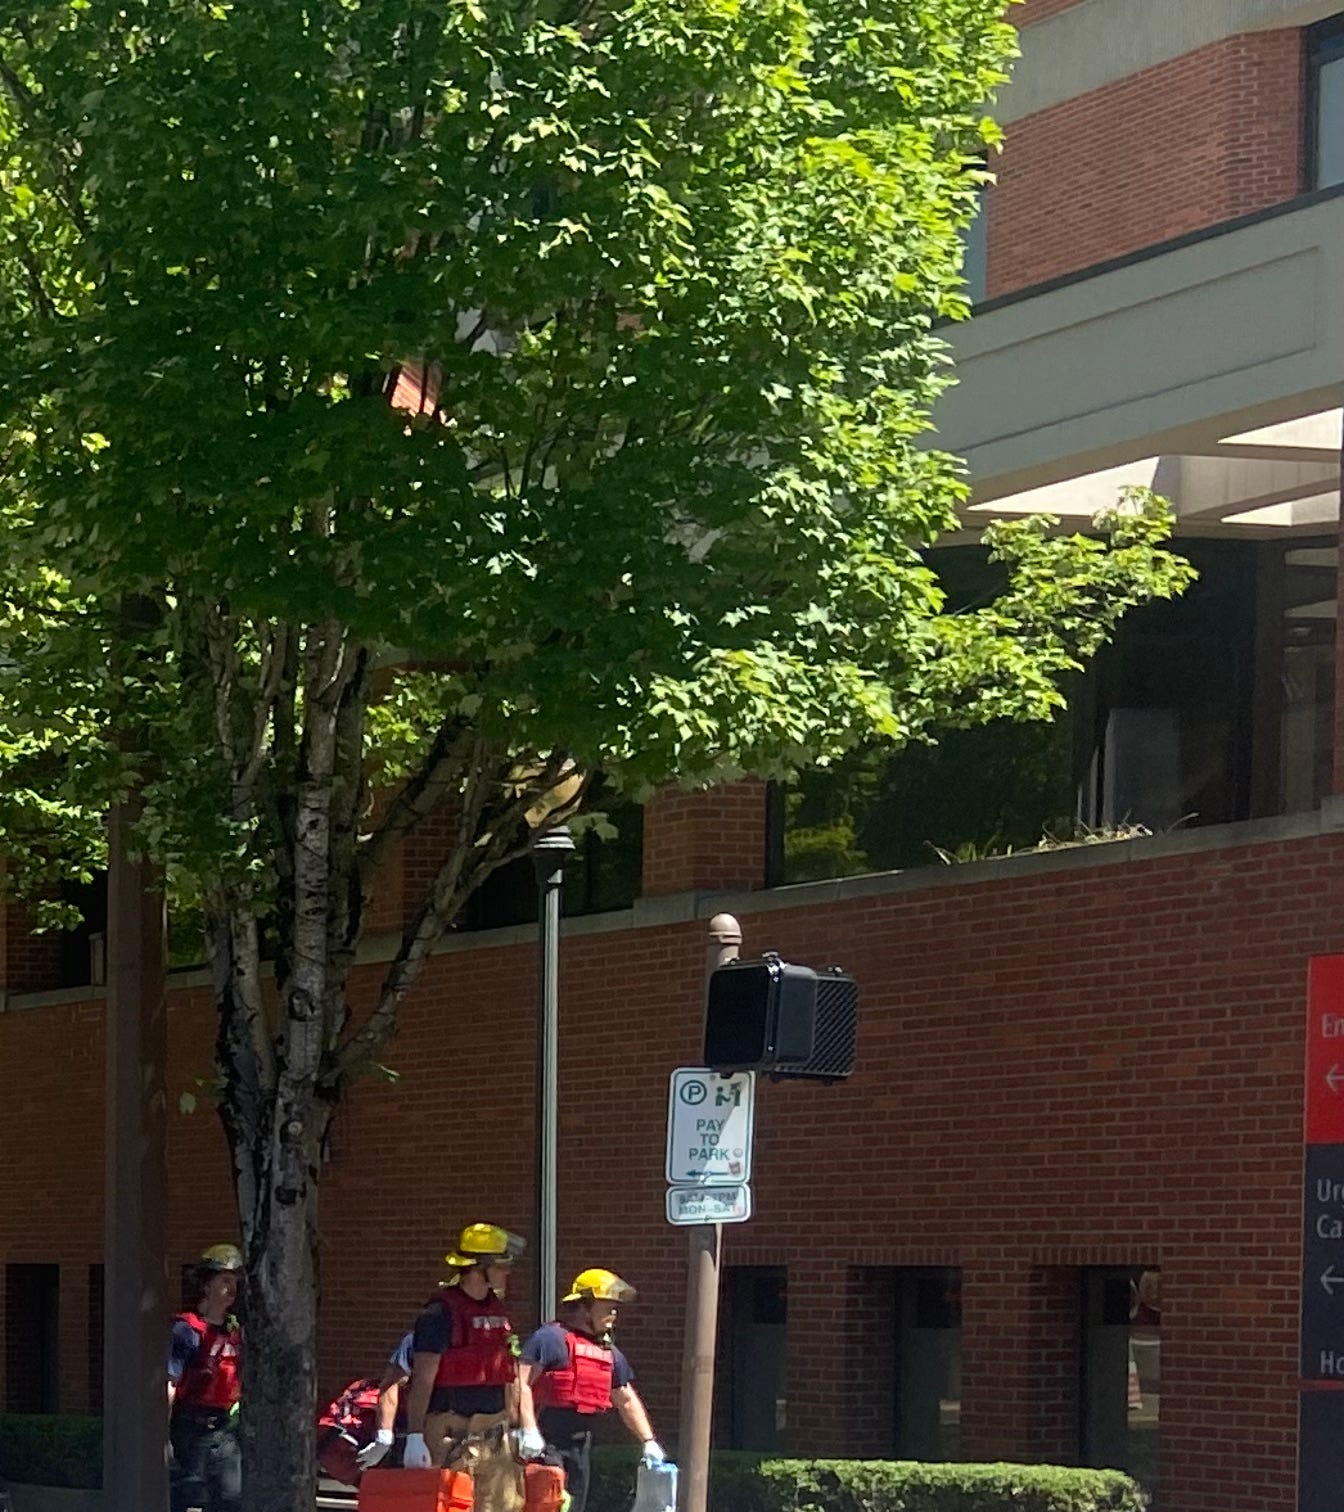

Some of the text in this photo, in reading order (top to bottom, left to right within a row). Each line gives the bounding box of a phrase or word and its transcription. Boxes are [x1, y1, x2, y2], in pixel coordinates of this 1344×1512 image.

[696, 1119, 725, 1132] PAY
[699, 1133, 720, 1146] TO
[688, 1147, 730, 1161] PARK
[1316, 1179, 1344, 1208] Ur
